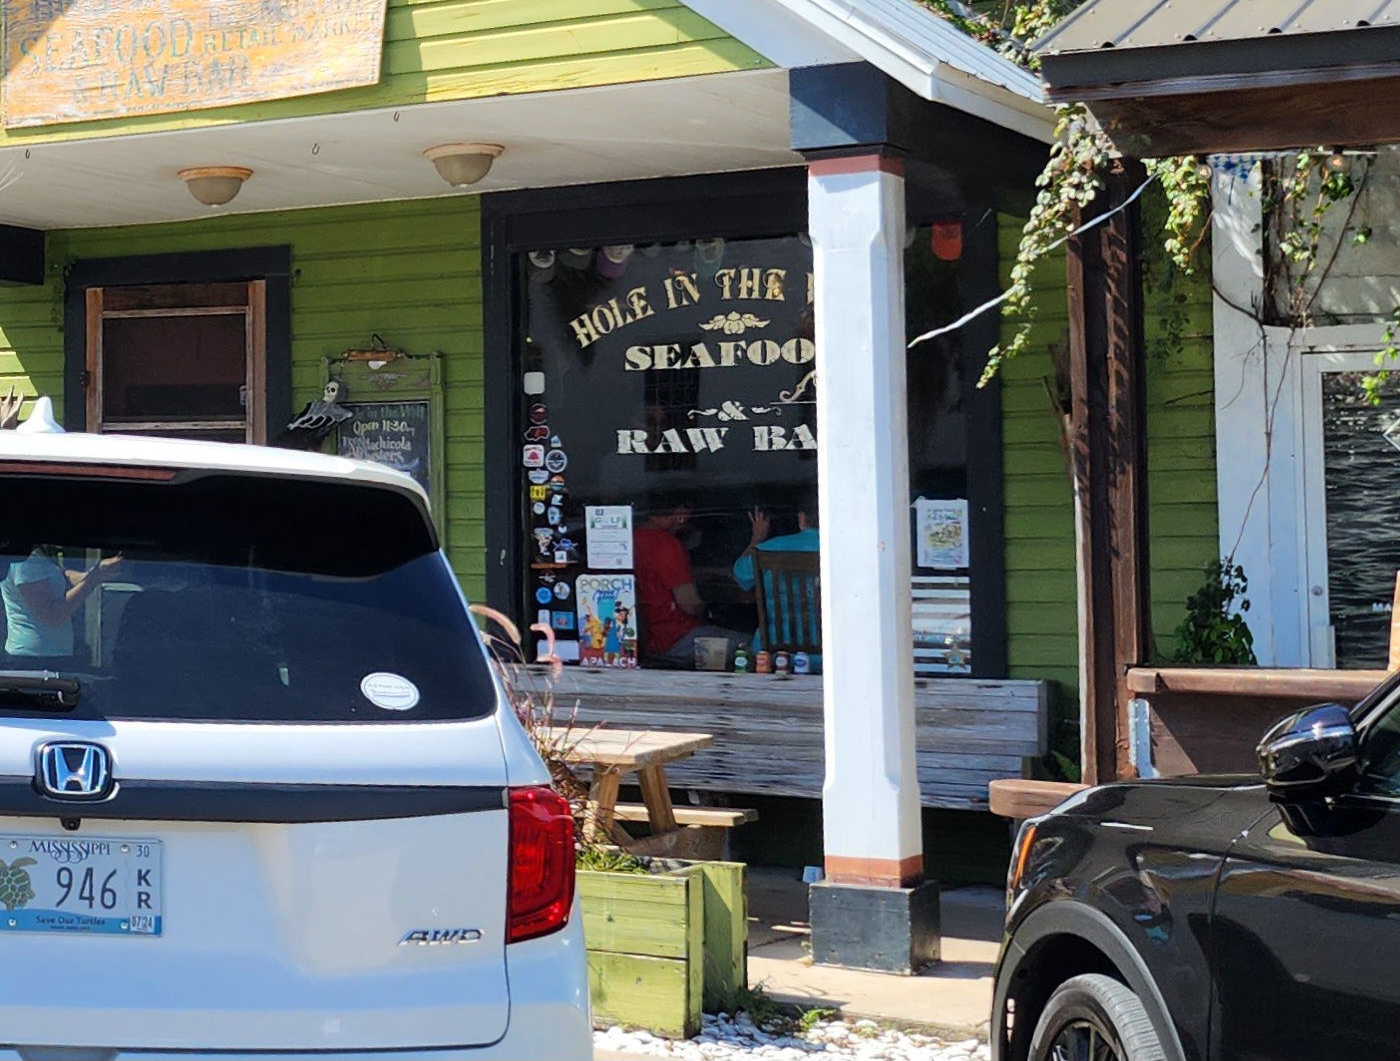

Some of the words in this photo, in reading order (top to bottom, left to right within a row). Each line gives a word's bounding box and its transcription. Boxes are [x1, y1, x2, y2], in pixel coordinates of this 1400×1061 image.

[569, 286, 656, 349] HOLE
[662, 272, 701, 310] IN
[714, 267, 787, 301] THE
[624, 338, 815, 371] SEAFOO
[717, 400, 750, 422] &
[353, 421, 380, 436] Open
[616, 427, 730, 454] RAW
[752, 424, 818, 452] BA
[581, 579, 633, 592] PORCH
[29, 840, 111, 864] MISSISSIPPI
[55, 867, 118, 910] 946
[35, 916, 55, 925] Save
[57, 916, 75, 925] Our
[76, 916, 106, 926] Turtles
[397, 928, 485, 946] AWD
